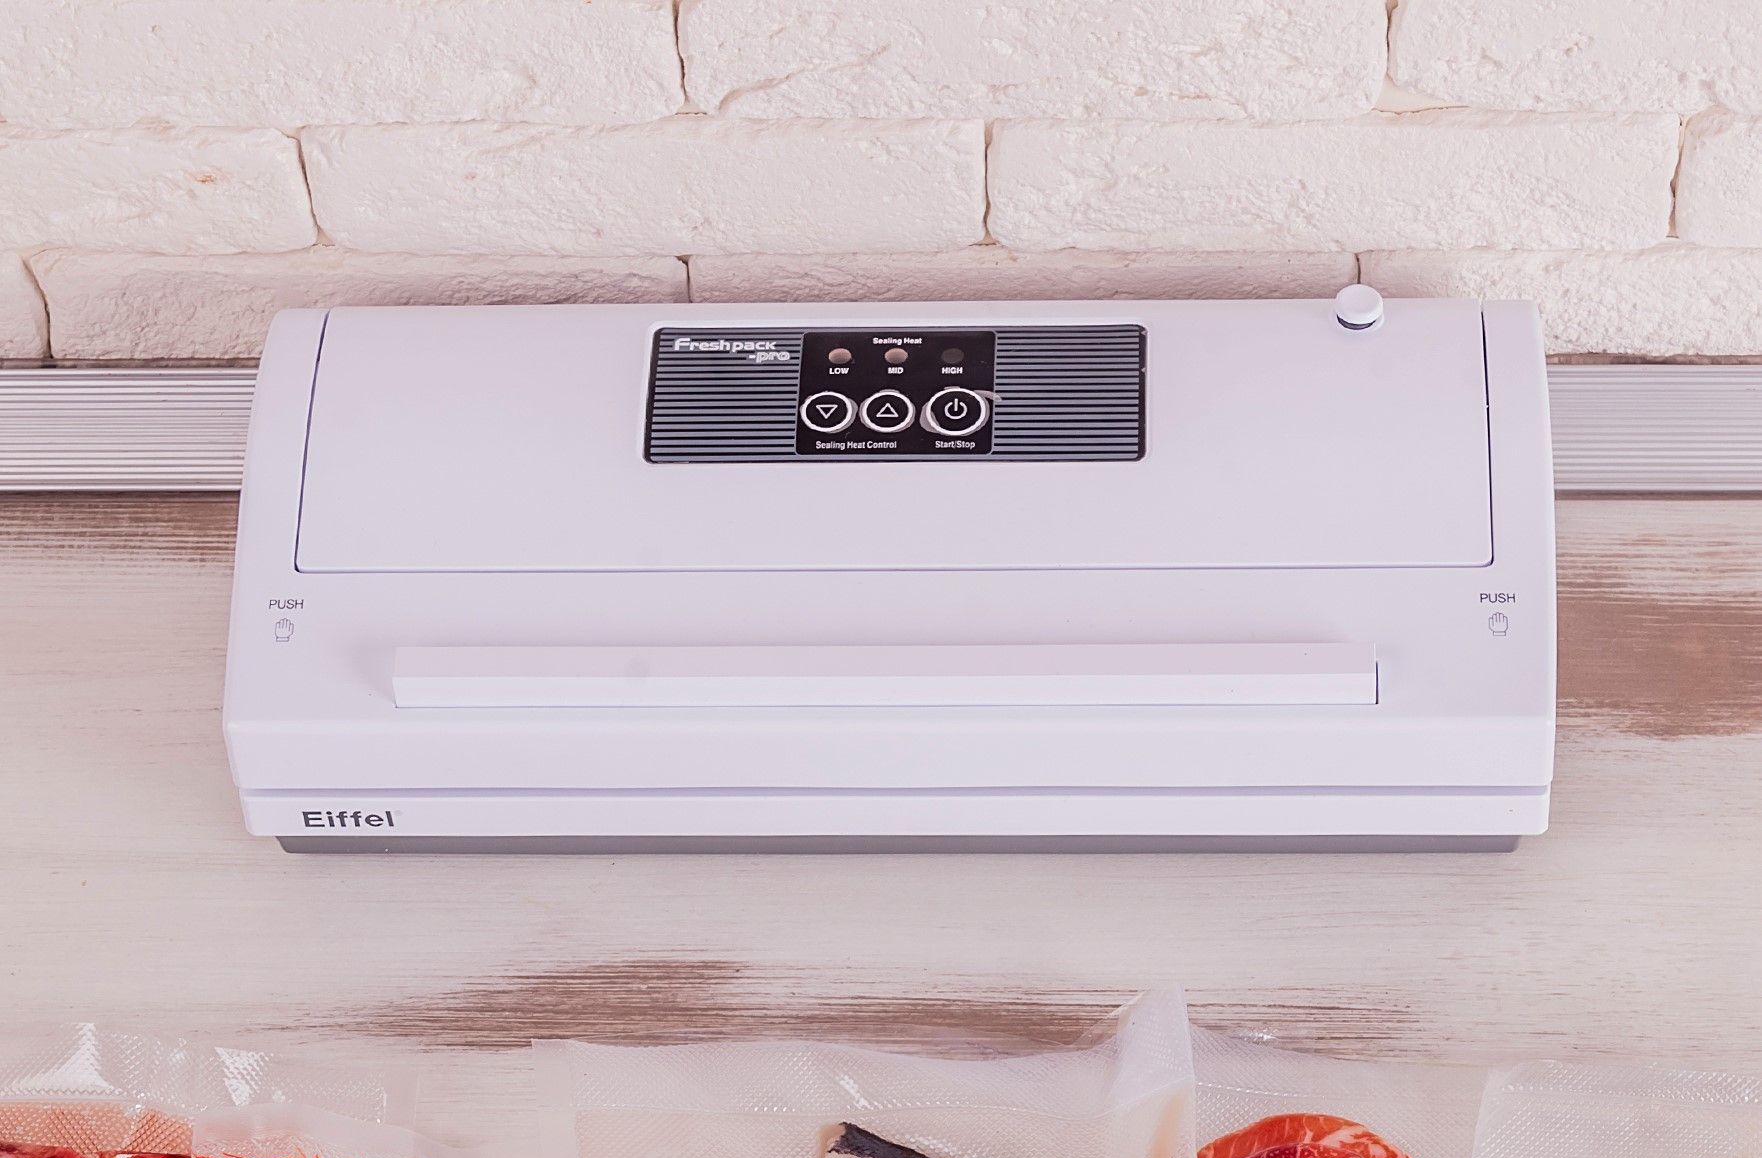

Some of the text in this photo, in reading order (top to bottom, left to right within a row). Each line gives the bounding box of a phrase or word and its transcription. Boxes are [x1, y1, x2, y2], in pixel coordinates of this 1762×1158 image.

[674, 337, 777, 352] Freshpack
[872, 337, 902, 346] Sealing
[829, 367, 849, 375] LOW
[815, 441, 897, 450] Sealing Heat Control
[935, 440, 976, 449] Start/Stop
[1479, 592, 1516, 603] PUSH
[269, 598, 304, 609] PUSH
[302, 811, 394, 827] Eiffel
